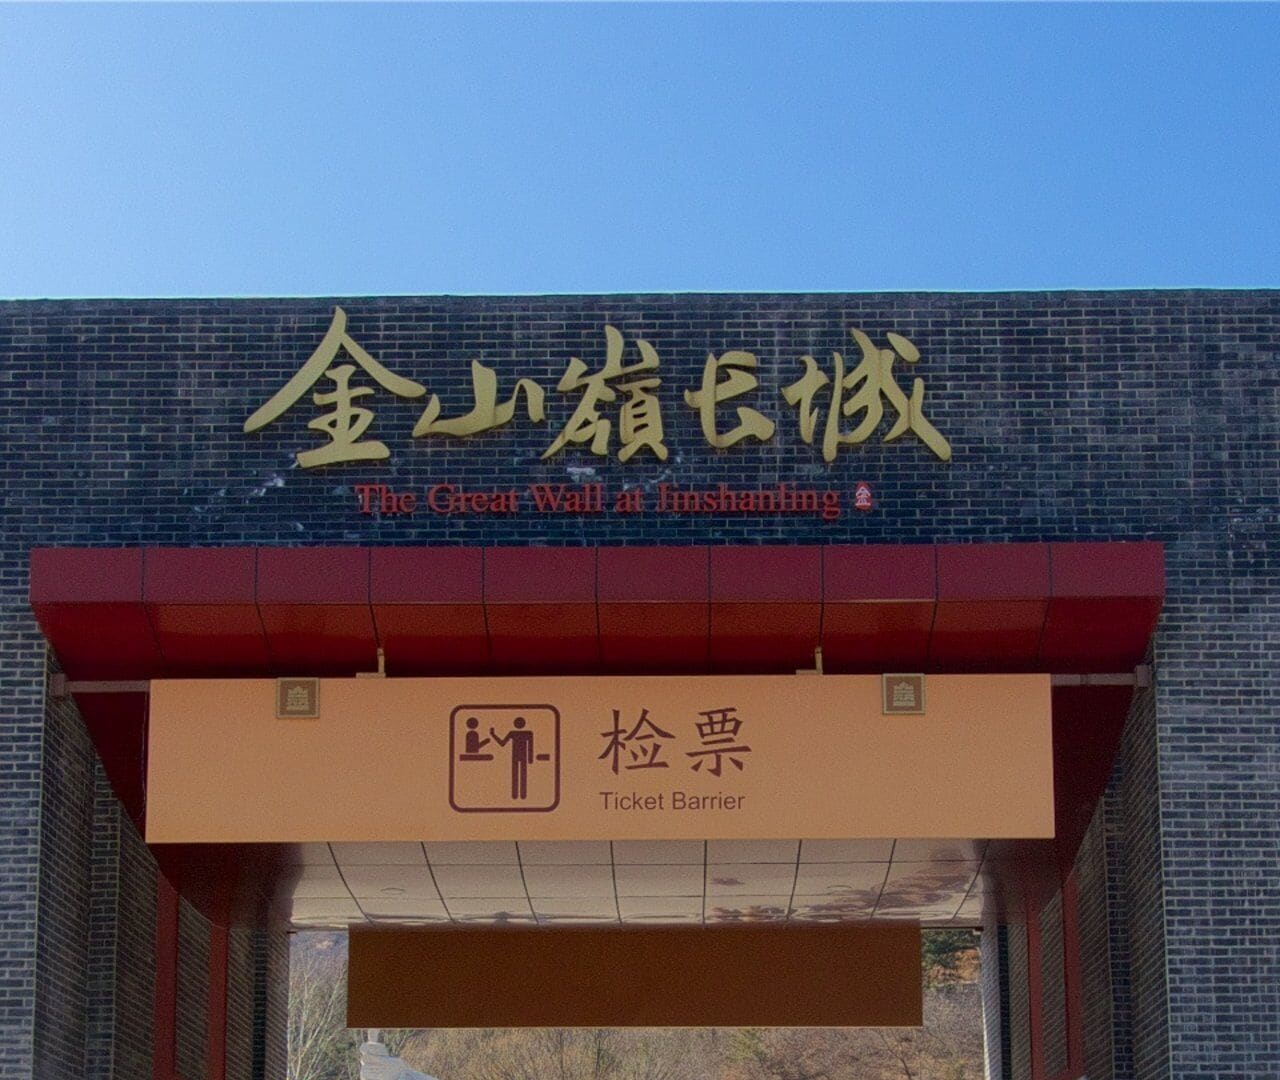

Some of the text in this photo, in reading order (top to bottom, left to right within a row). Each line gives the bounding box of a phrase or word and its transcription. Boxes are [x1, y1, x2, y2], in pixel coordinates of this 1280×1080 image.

[354, 482, 841, 520] The Great Wall at Jinshanling
[597, 707, 752, 777] 检票
[599, 791, 746, 811] Ticket Barrier
